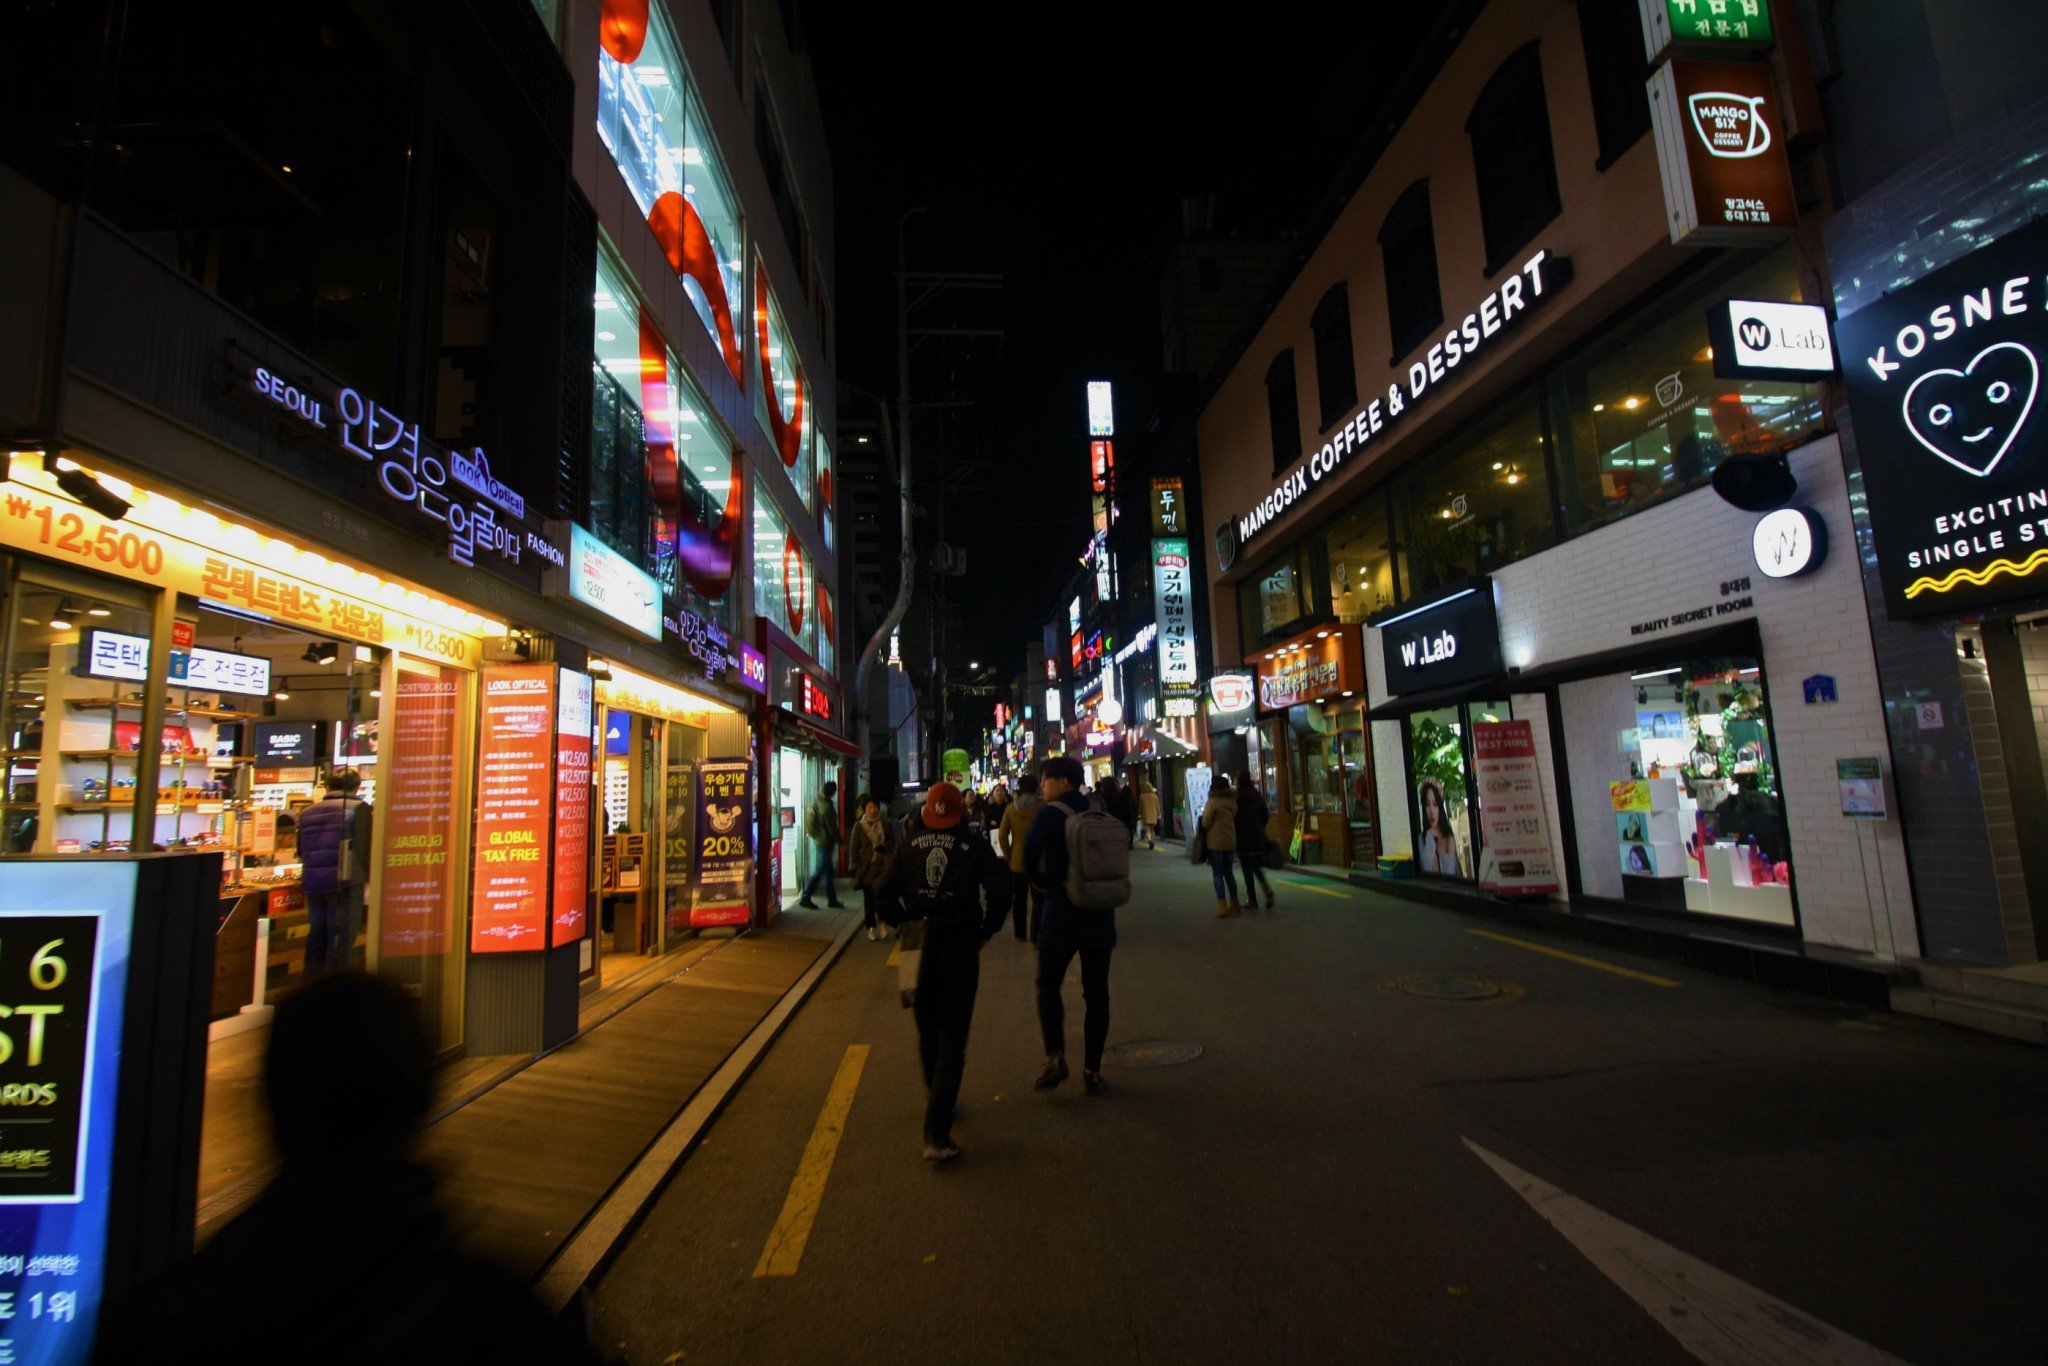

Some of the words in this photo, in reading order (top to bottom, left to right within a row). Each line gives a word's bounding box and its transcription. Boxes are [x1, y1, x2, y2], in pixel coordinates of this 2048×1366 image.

[1695, 19, 1748, 38] 전문점
[1699, 106, 1748, 121] MANGO
[1715, 118, 1736, 129] SIX
[1713, 138, 1743, 146] DESSERT
[1714, 132, 1741, 140] COFFEE
[1725, 198, 1765, 210] 망고식스
[1867, 275, 2048, 382] KOSNE
[254, 367, 327, 429] SEOUL
[1240, 465, 1307, 543] MANGOSIX
[1310, 398, 1384, 482] COFFEE
[1388, 382, 1404, 416] &
[1409, 249, 1546, 400] DESSERT
[337, 387, 450, 522] 안경은
[449, 501, 522, 568] 얼굴이다
[453, 455, 483, 482] LOOK
[489, 480, 524, 511] Optical
[527, 532, 565, 568] FASHION
[1908, 530, 2005, 569] SINGLE
[1720, 576, 1752, 596] 홍대점
[201, 557, 323, 624] 콘택트렌즈
[328, 597, 384, 643] 전문점
[1631, 617, 1670, 635] BEAUTY
[1671, 606, 1714, 626] SECRET
[1716, 596, 1753, 615] ROOM
[214, 659, 264, 688] 전문점
[487, 680, 510, 691] LOOK
[512, 679, 548, 690] OPTICAL
[269, 733, 302, 745] BASIC
[704, 774, 745, 785] 우승기념
[489, 831, 536, 845] GLOBAL
[484, 848, 507, 863] TAX
[509, 847, 540, 861] FREE
